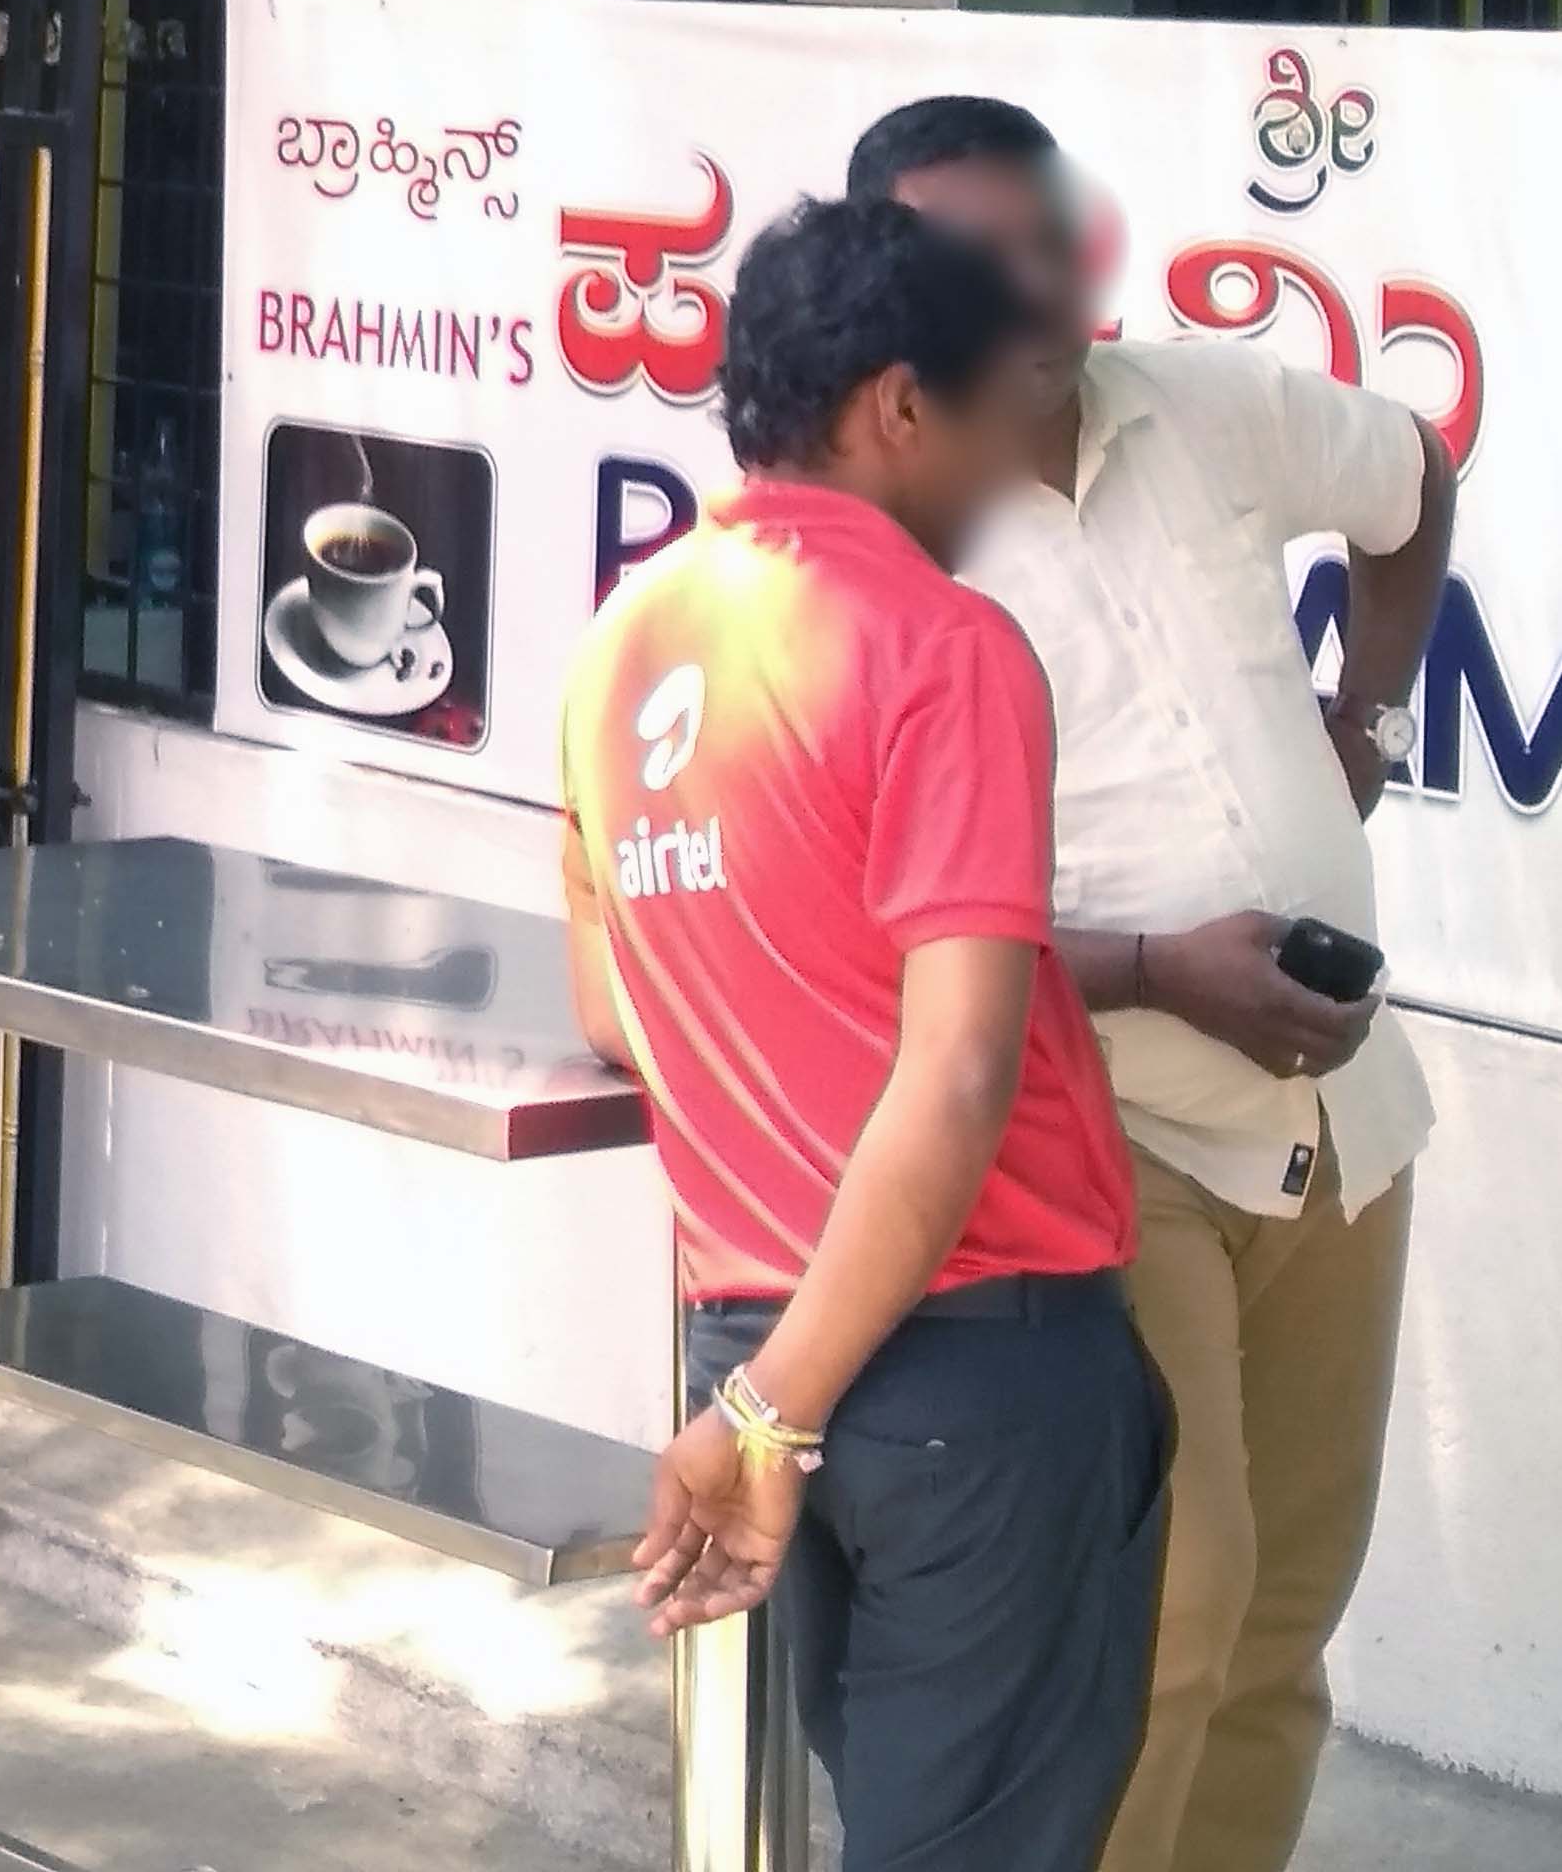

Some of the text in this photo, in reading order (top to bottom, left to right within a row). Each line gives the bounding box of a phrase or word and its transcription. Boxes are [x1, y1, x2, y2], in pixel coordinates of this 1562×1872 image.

[1247, 47, 1378, 213] ಶ್ರೀ
[258, 289, 534, 384] BRAHMIN'S
[617, 815, 728, 898] airtel
